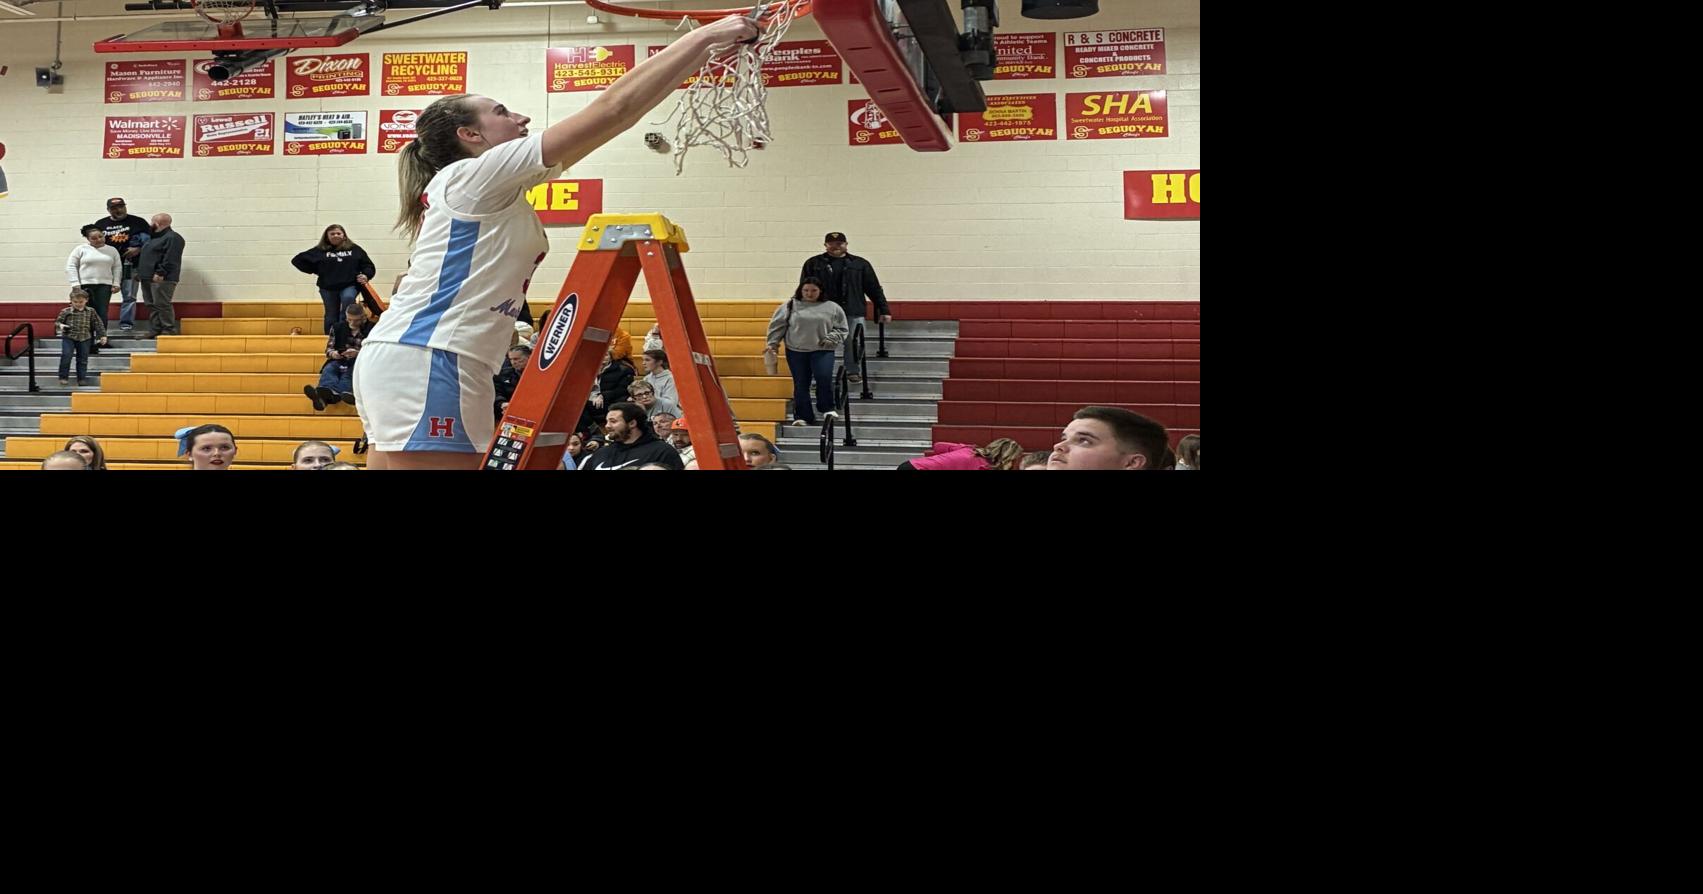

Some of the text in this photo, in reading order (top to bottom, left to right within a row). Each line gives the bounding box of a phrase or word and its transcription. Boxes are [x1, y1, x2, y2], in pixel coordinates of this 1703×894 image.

[1068, 30, 1160, 44] R & S CONCRETE
[768, 47, 821, 56] eoples
[994, 45, 1032, 54] nited
[384, 53, 466, 64] SWEETWATER
[293, 56, 363, 75] Dixon
[391, 64, 458, 76] RECYCLING
[1096, 63, 1161, 73] SEQUOYAH
[778, 72, 838, 81] SEQUOYAH
[574, 78, 616, 86] SEQUOY
[218, 88, 271, 96] SEQUOYAH
[312, 84, 366, 93] SEQUOYAH
[408, 84, 462, 92] SEQUOYAH
[129, 91, 182, 99] SEQUOYAH
[1081, 94, 1152, 116] SHA
[109, 120, 160, 128] Walmart
[201, 115, 267, 132] Russell
[990, 128, 1053, 137] SEQUOYAH
[1098, 125, 1163, 135] SEQUOYAH
[217, 144, 270, 152] SEQUOYAH
[309, 142, 364, 150] SEQUOYAH
[526, 182, 578, 210] ME
[546, 308, 571, 354] WERNER
[429, 416, 455, 438] H
